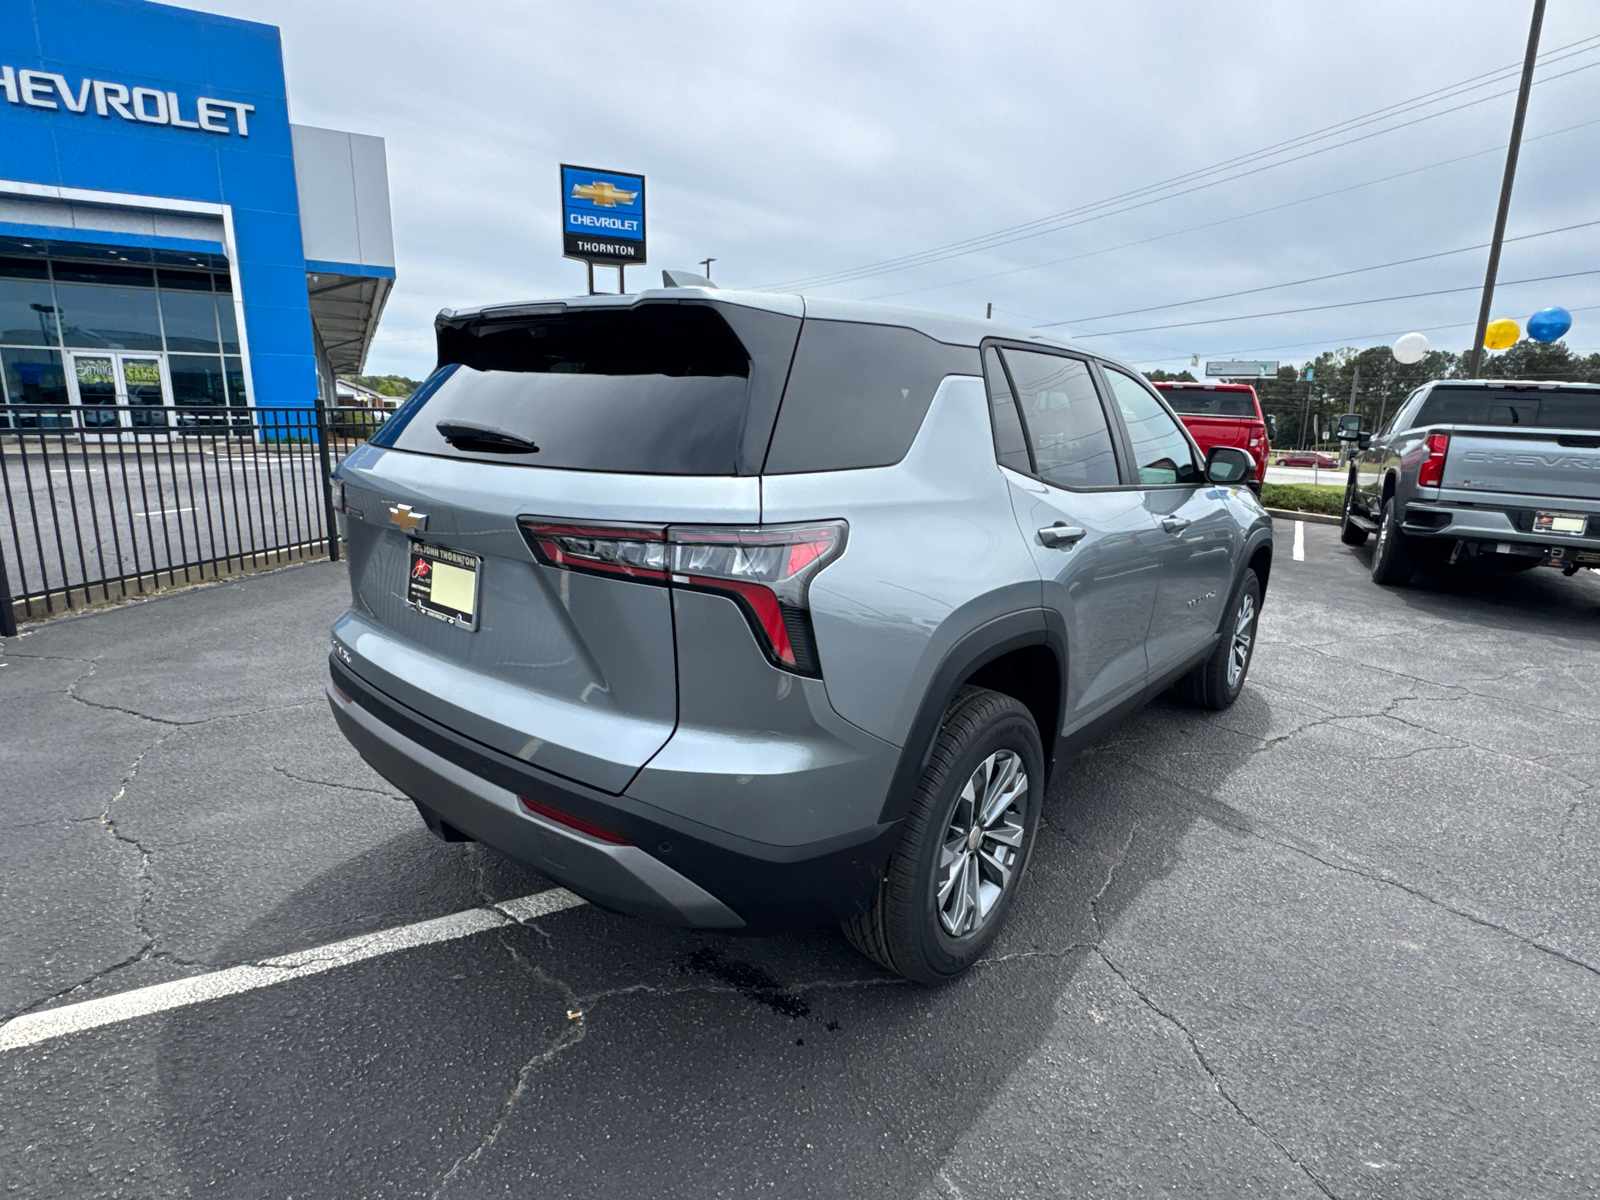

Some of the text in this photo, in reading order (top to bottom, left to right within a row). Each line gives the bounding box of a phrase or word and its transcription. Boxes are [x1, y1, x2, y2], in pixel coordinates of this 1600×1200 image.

[570, 213, 638, 231] CHEVROLET
[577, 241, 635, 256] THORNTON
[423, 545, 475, 567] JOHN THORNTON
